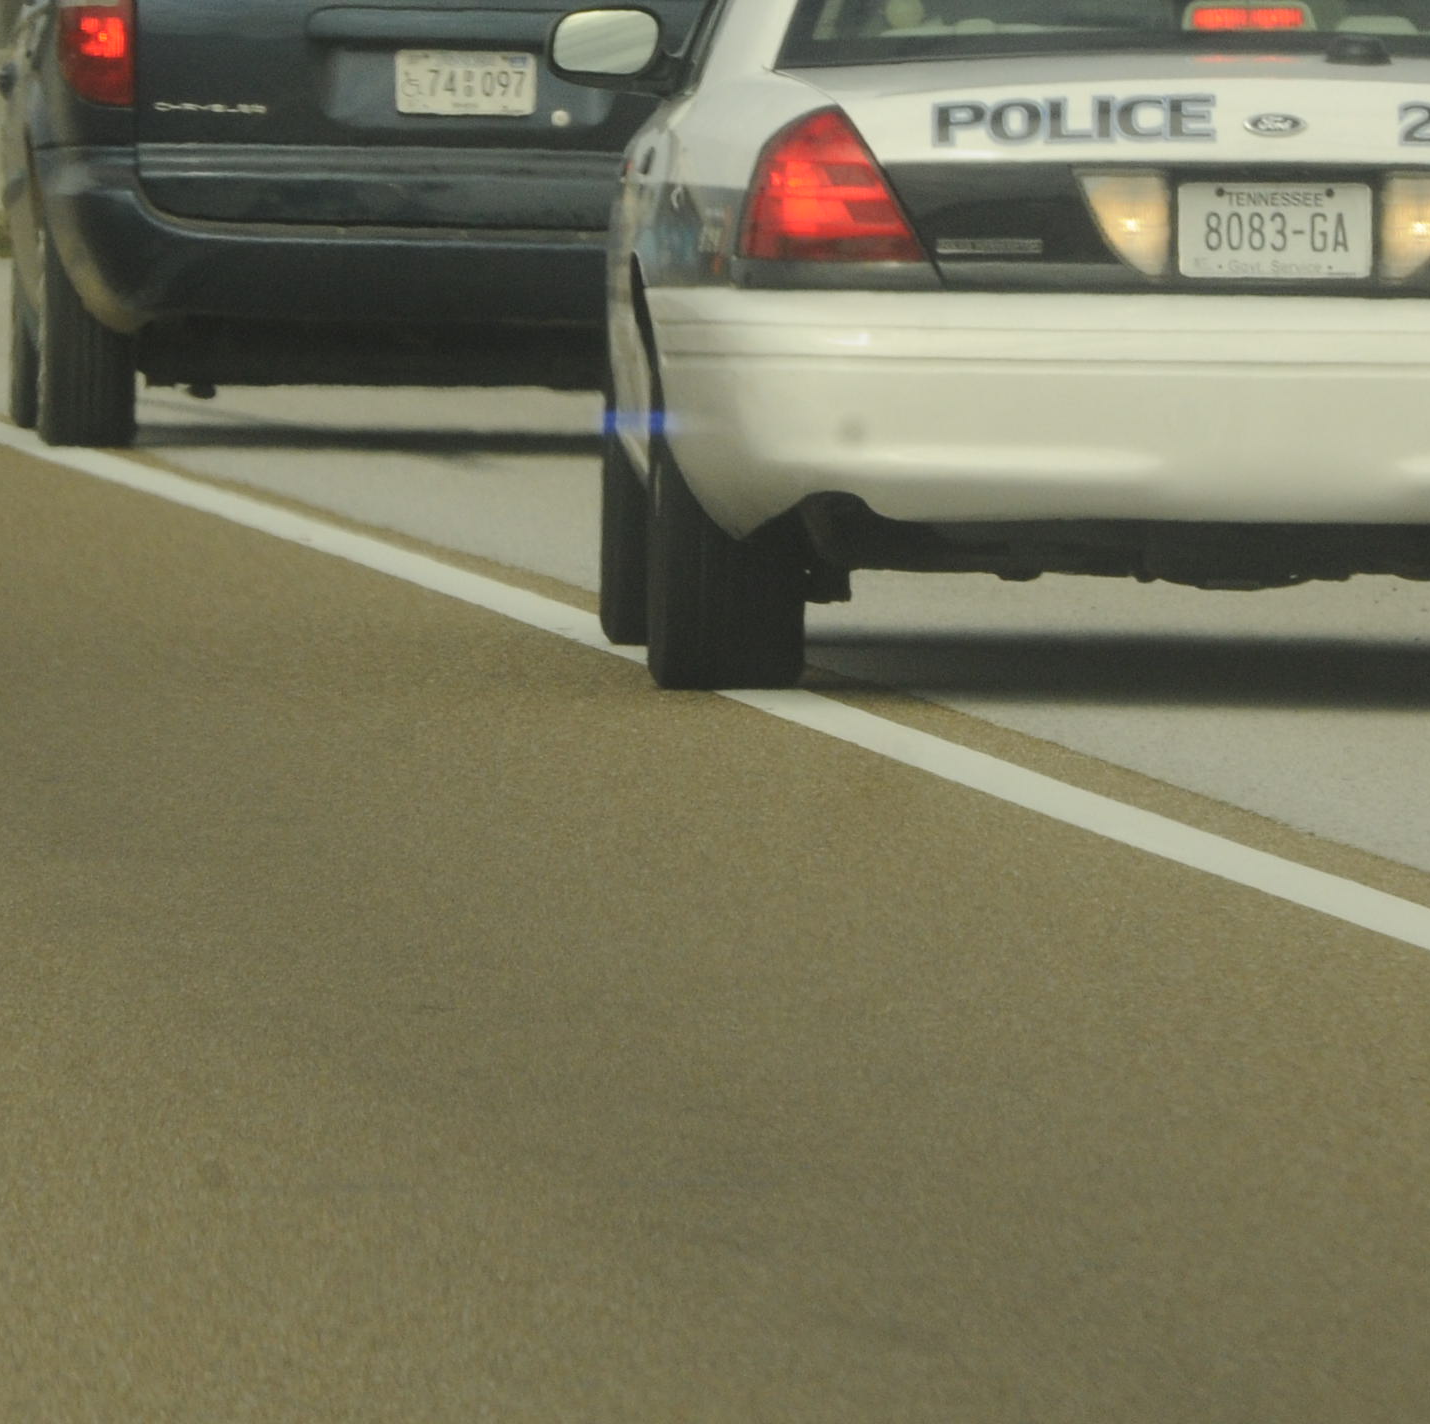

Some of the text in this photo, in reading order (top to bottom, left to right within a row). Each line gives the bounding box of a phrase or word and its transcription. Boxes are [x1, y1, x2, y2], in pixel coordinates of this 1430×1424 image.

[480, 70, 527, 99] 097
[932, 93, 1217, 148] POLICE
[1226, 191, 1325, 208] TENNESSEE
[1204, 211, 1350, 253] 8083-GA
